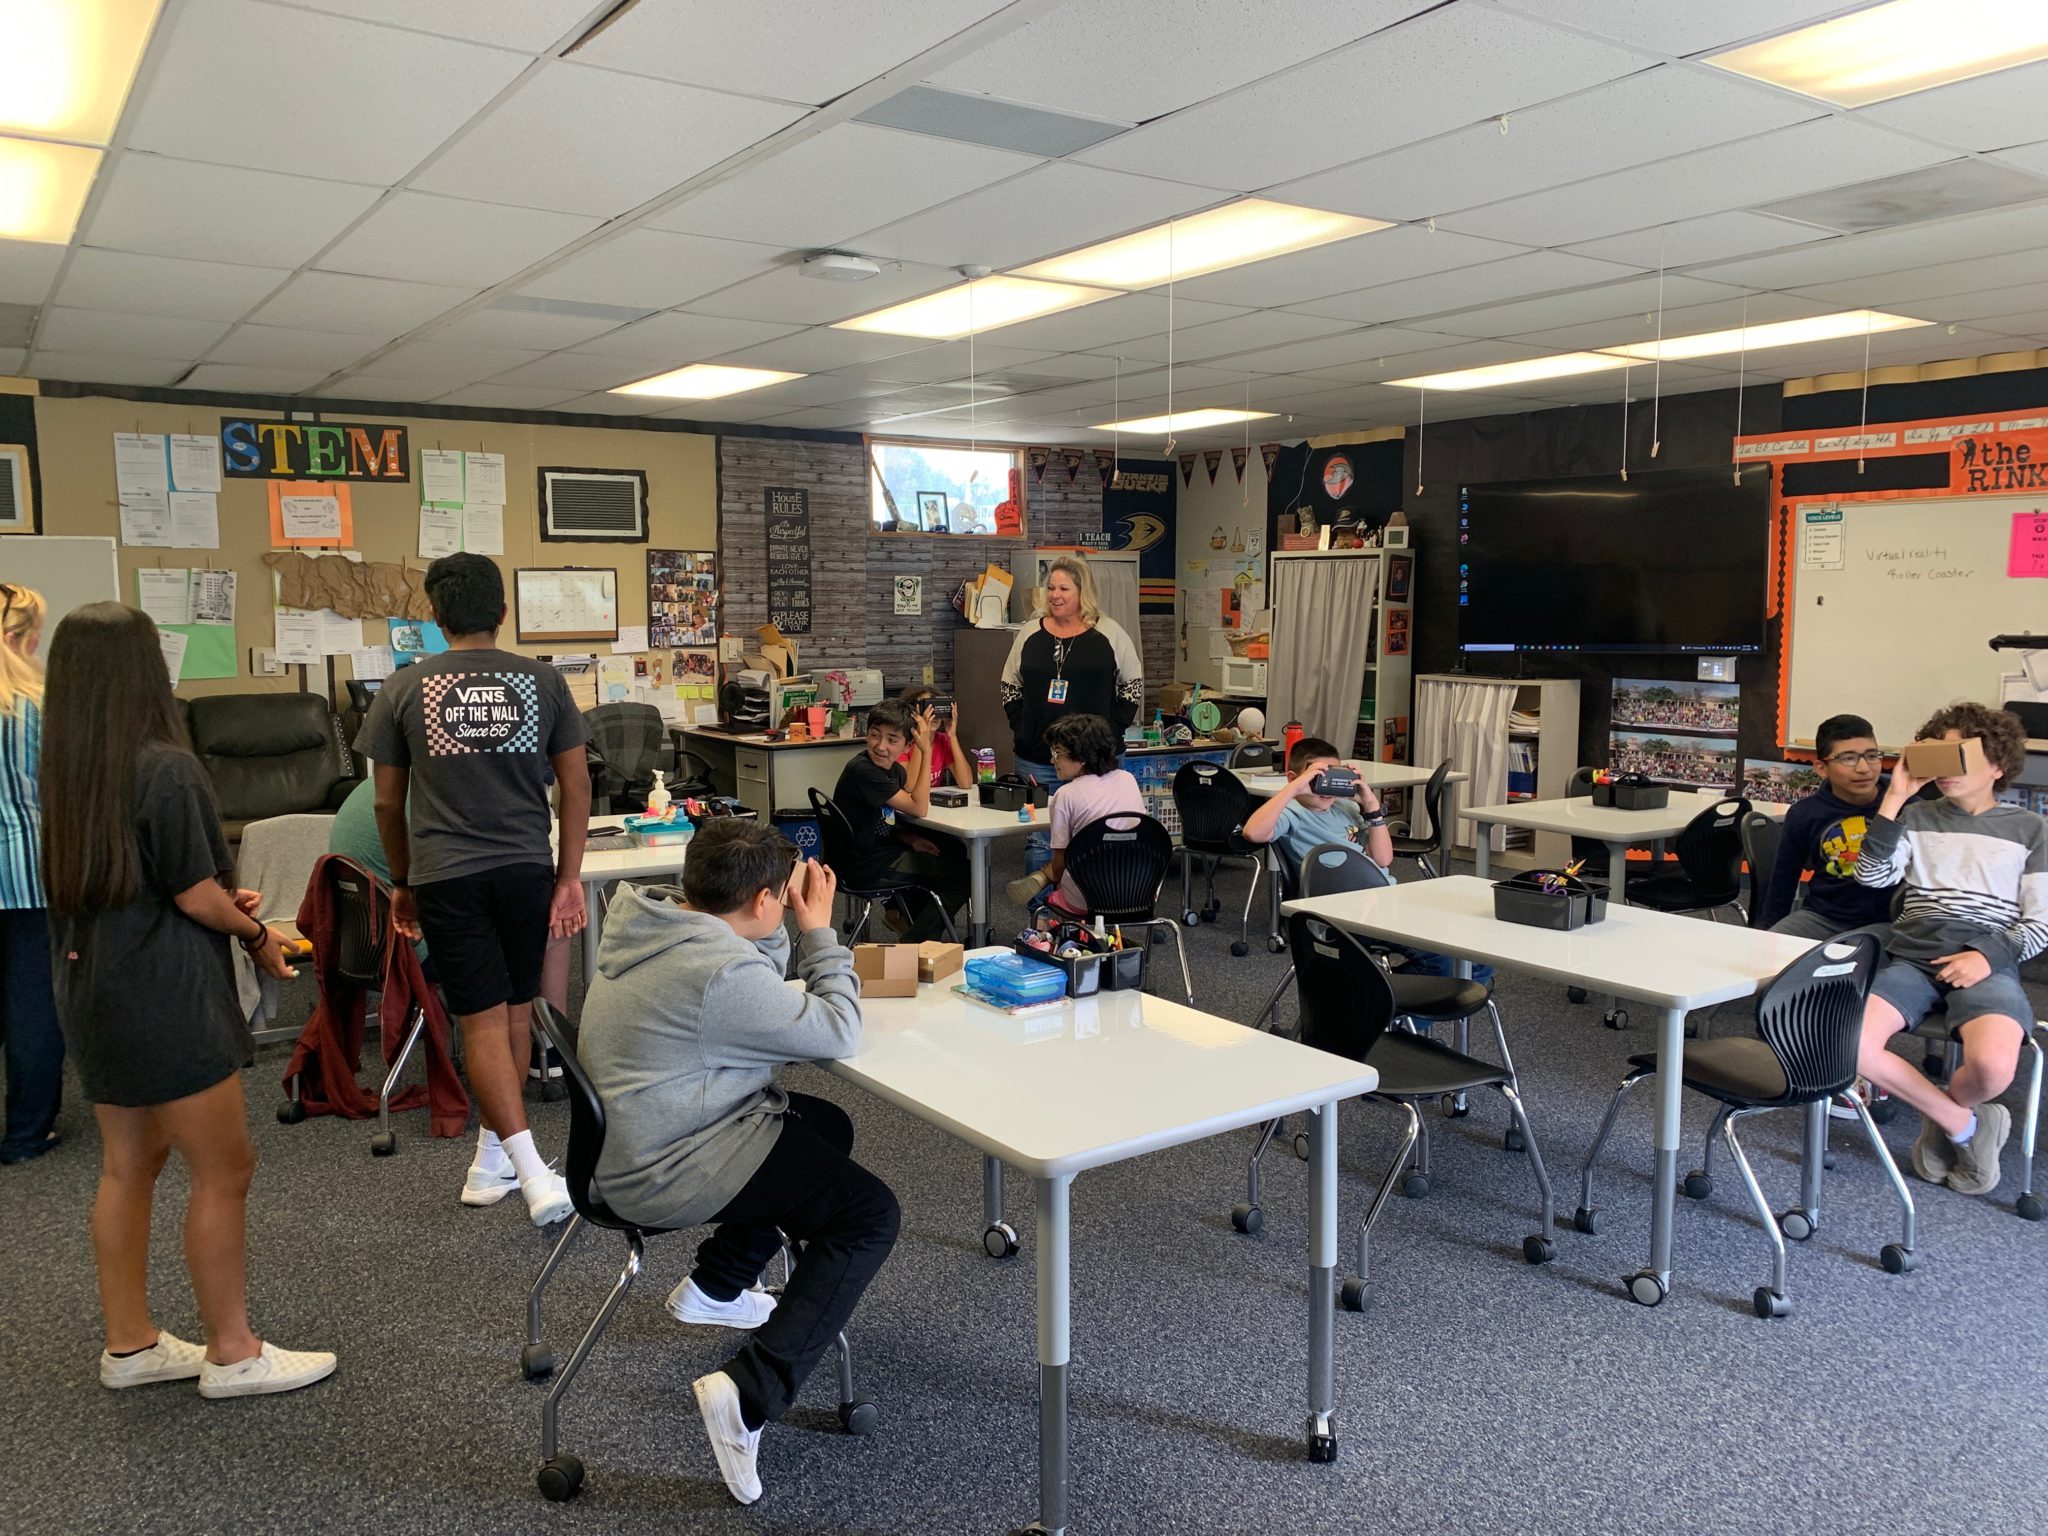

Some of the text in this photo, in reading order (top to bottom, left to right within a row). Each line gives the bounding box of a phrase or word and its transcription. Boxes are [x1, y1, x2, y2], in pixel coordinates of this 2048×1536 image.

[222, 422, 405, 478] STEM
[1981, 442, 2031, 466] the
[1967, 463, 2048, 492] RINK
[1110, 480, 1168, 494] DUCKS
[772, 503, 802, 514] RULES
[1085, 533, 1111, 541] TEACH
[1866, 544, 1947, 560] Virtual reality
[780, 611, 809, 620] PLEASE
[455, 687, 505, 703] VANS
[445, 705, 520, 722] OFF THE WALL
[455, 723, 511, 737] Since '66
